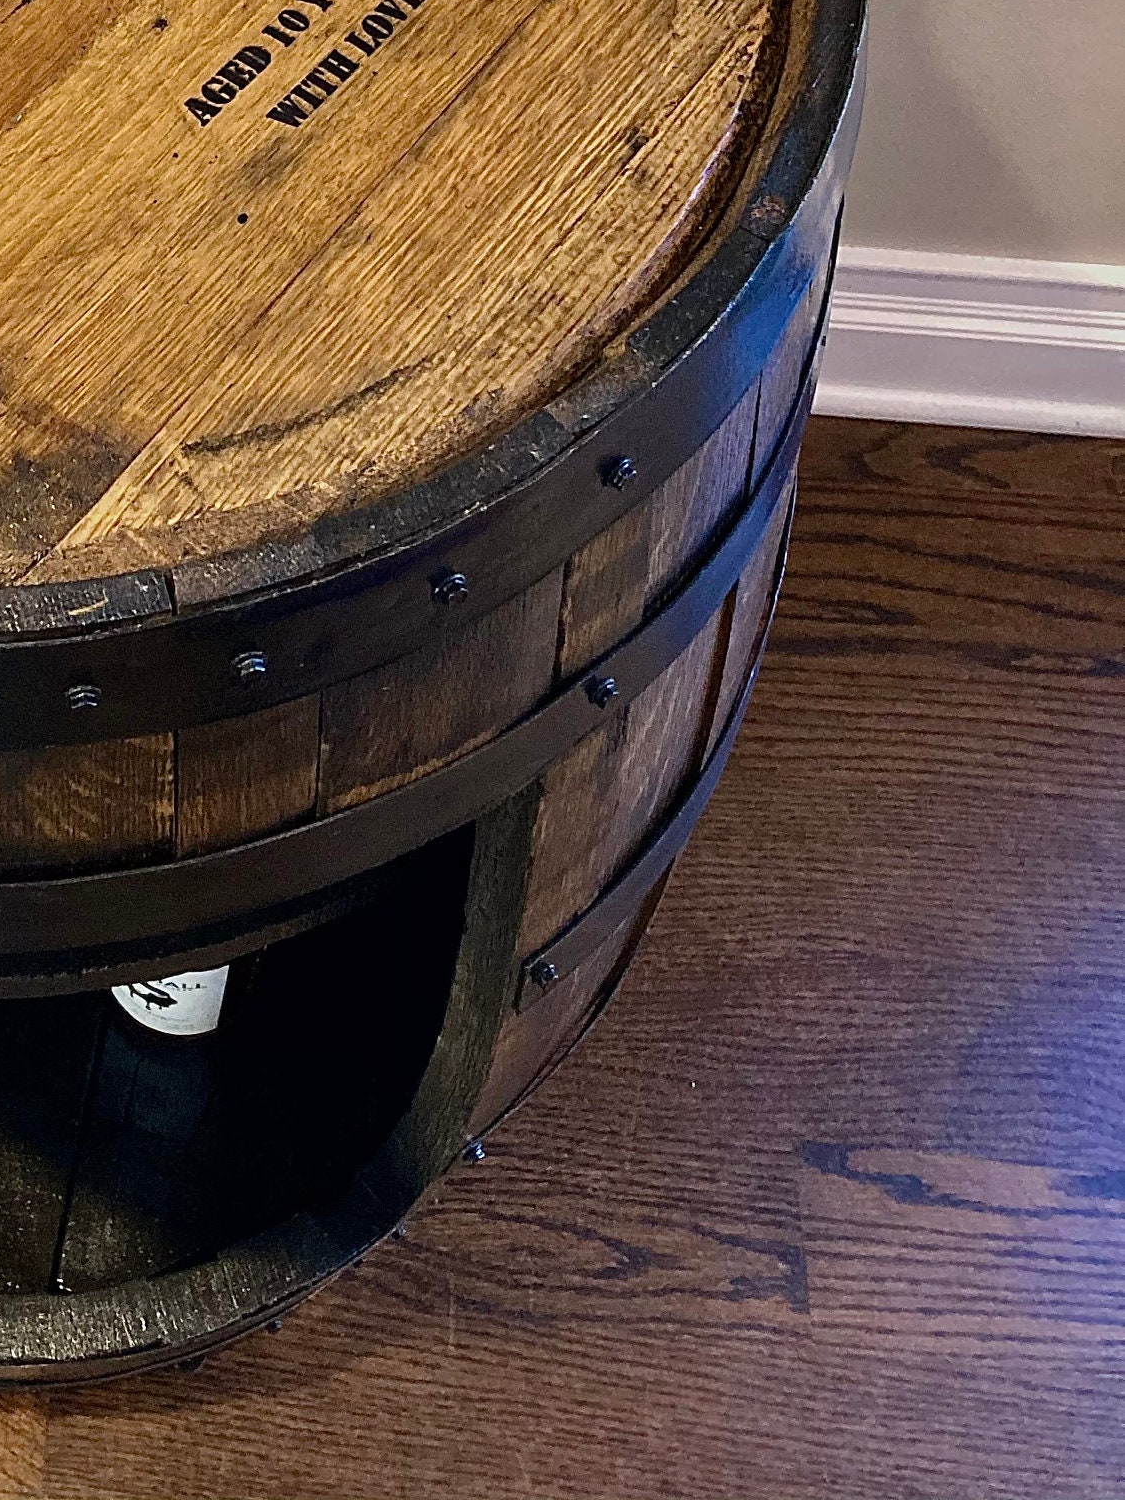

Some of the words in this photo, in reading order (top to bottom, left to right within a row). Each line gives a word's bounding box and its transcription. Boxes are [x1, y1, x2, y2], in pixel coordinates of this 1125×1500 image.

[184, 45, 272, 127] AGED
[261, 9, 310, 47] 10
[265, 49, 360, 128] WITH
